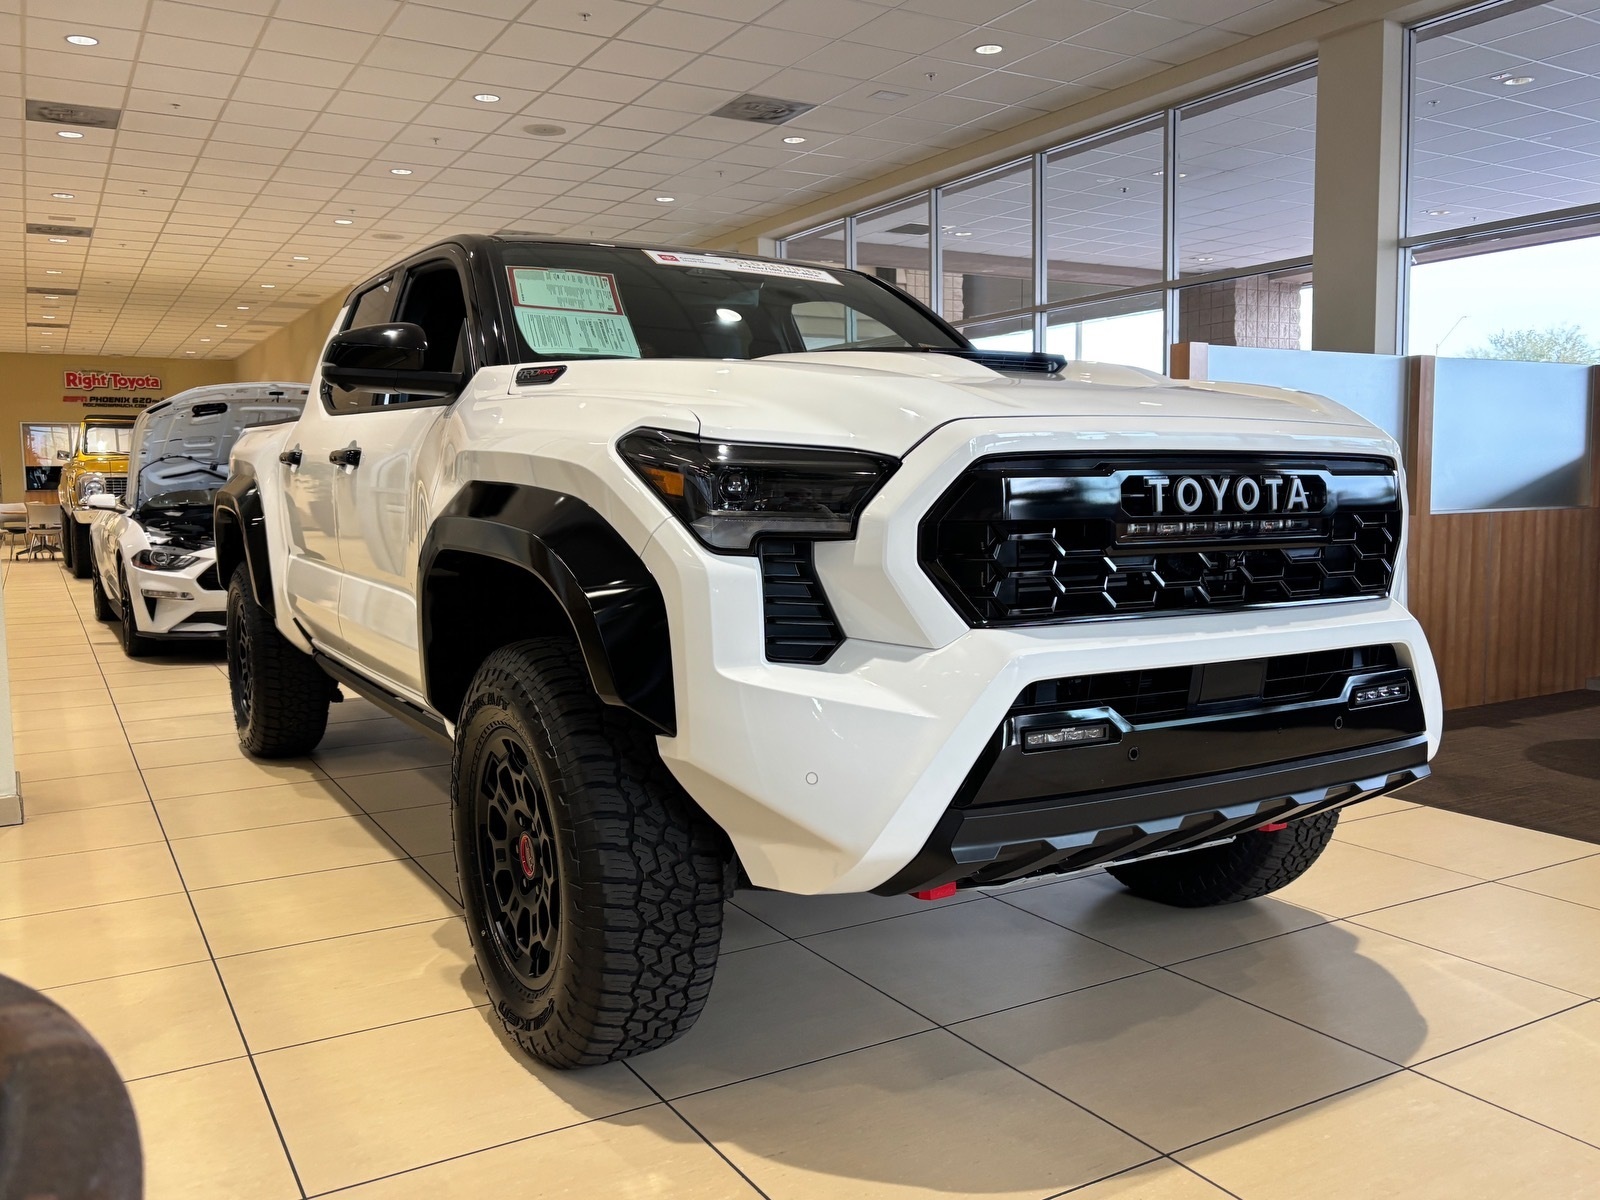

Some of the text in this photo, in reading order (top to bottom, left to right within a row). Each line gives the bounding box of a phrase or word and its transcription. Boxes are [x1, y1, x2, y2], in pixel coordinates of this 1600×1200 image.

[64, 371, 161, 391] Right Toyota
[1143, 475, 1310, 513] TOYOTA
